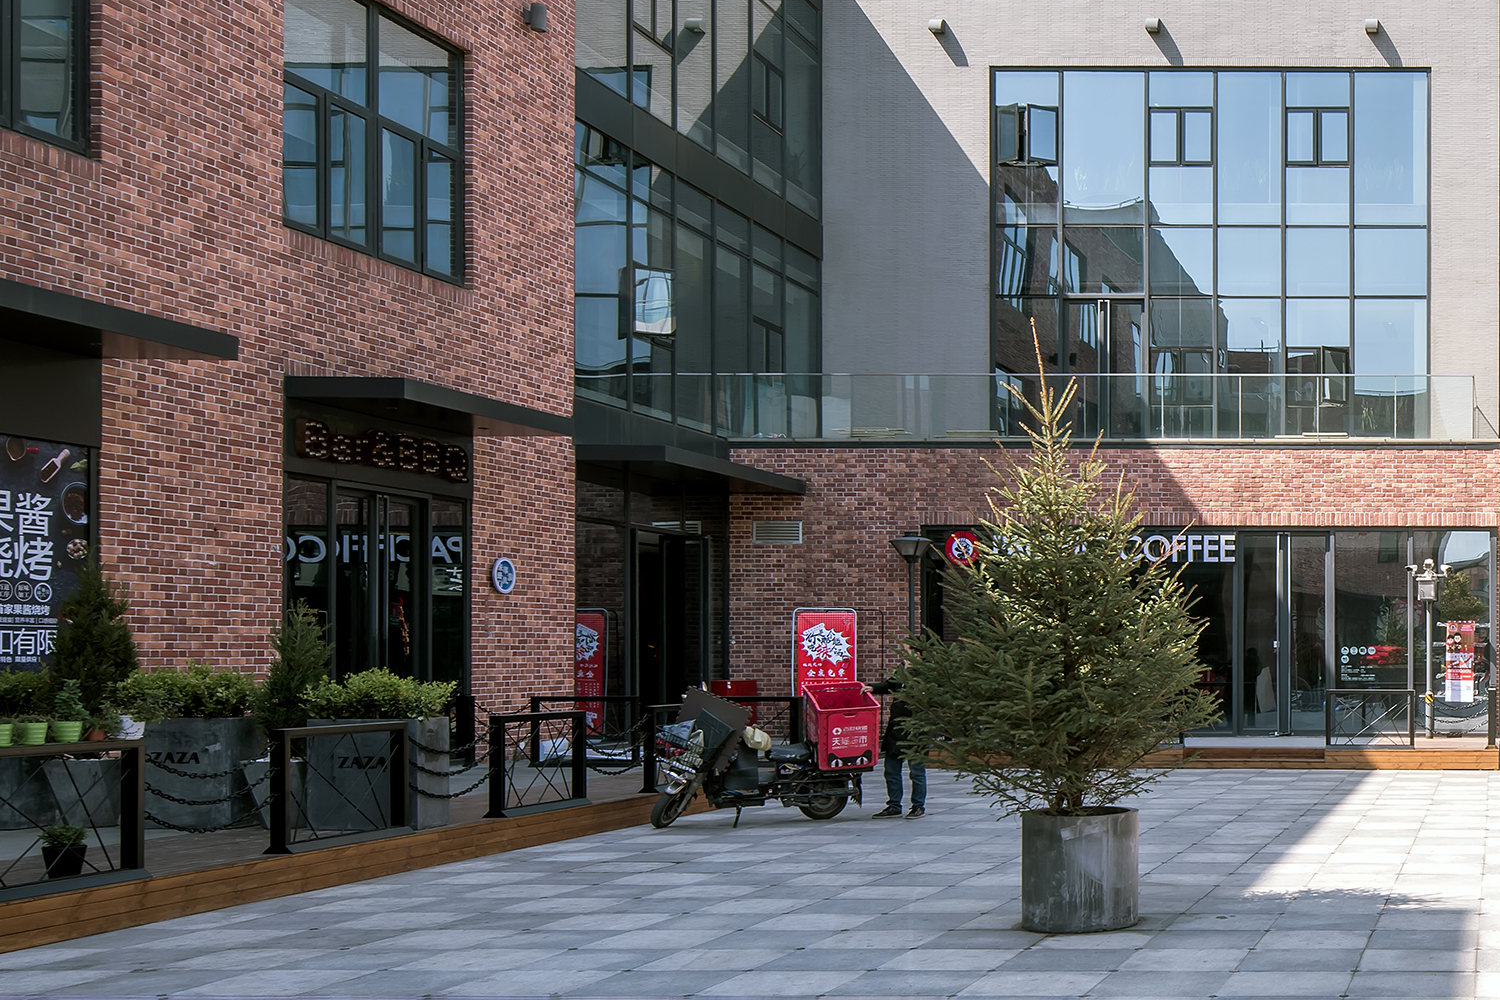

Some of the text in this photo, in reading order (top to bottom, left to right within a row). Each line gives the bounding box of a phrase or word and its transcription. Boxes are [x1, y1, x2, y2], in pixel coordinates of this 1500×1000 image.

[1119, 534, 1236, 563] COFFEE
[150, 751, 200, 765] ZAZA
[338, 756, 388, 772] ZAZA
